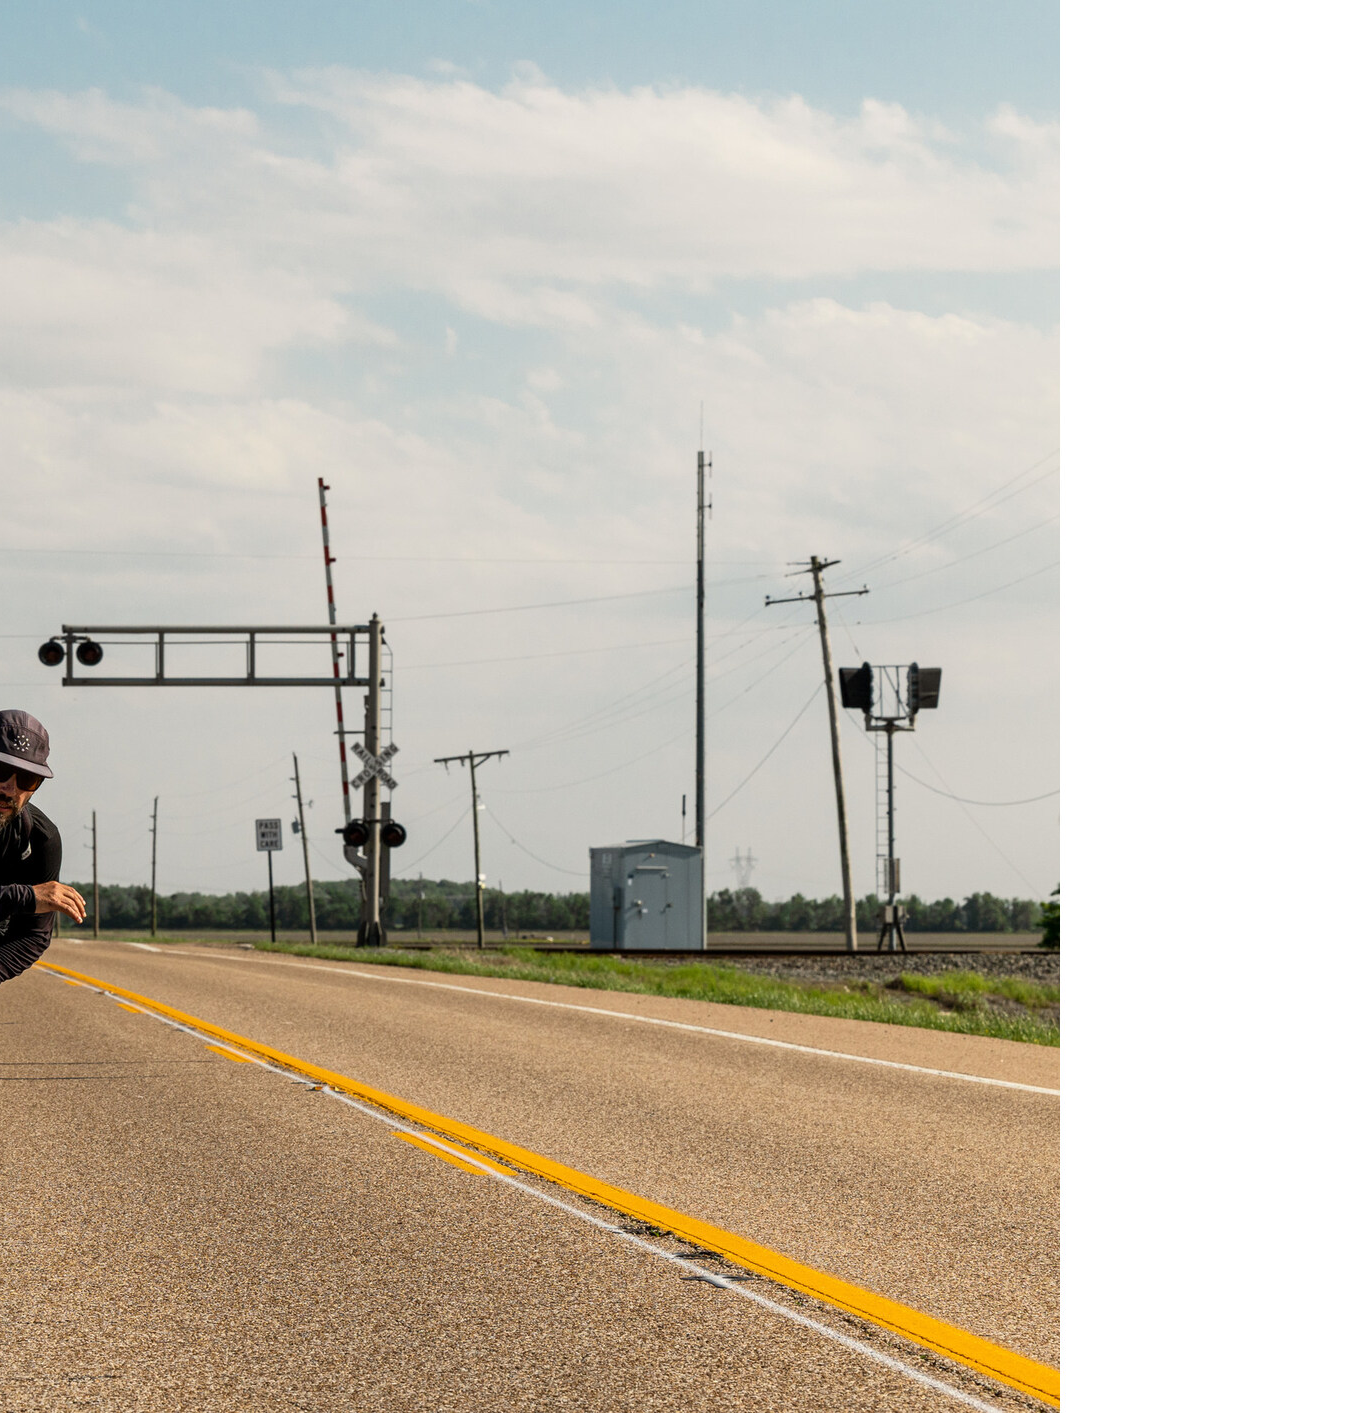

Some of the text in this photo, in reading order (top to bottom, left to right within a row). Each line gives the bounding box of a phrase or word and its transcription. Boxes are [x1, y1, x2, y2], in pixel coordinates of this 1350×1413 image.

[258, 821, 278, 830] PASS
[260, 831, 278, 839] WITH
[260, 840, 279, 848] CARE
